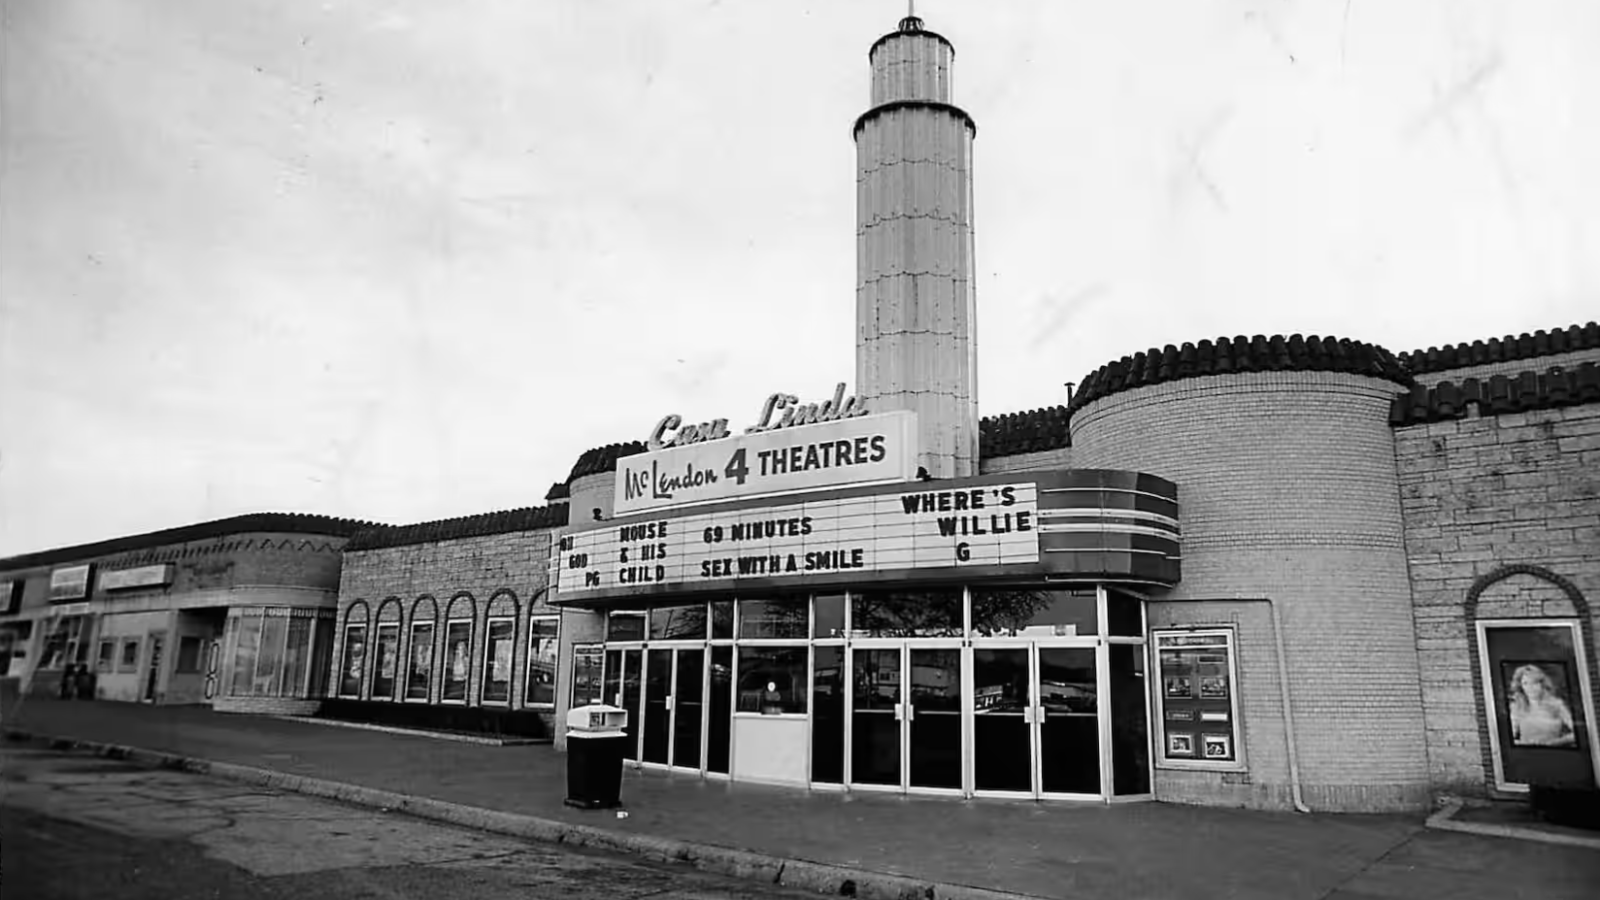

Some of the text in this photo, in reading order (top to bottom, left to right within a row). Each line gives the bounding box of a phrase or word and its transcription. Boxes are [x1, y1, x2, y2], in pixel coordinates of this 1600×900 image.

[745, 382, 869, 434] Linda
[724, 448, 749, 485] 4
[757, 435, 886, 477] THEATRES
[902, 486, 1016, 514] WHERE'S
[703, 516, 813, 544] 69 MINUTES
[937, 511, 1031, 537] WILLIE
[641, 543, 667, 562] HIS
[700, 548, 864, 578] SEX WITH A SMILE
[956, 542, 971, 562] G
[585, 570, 600, 587] PG
[619, 564, 665, 584] CHILD
